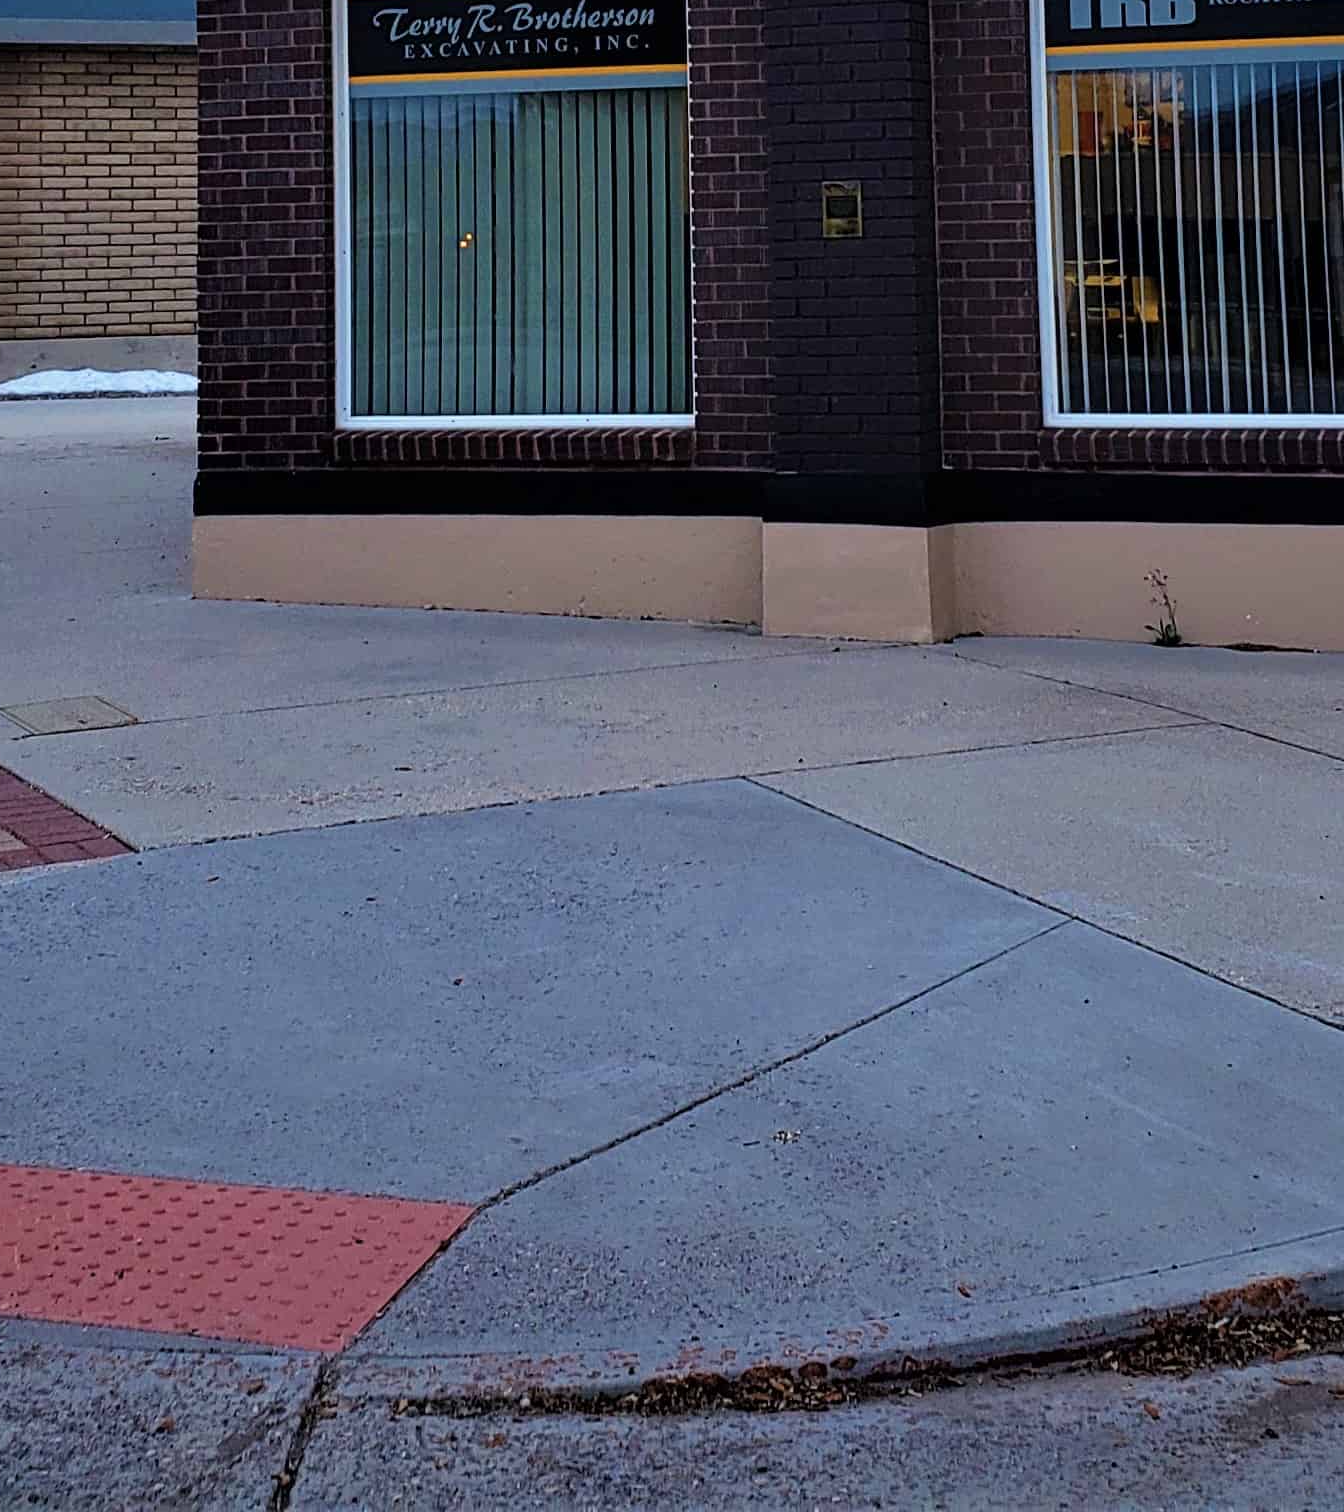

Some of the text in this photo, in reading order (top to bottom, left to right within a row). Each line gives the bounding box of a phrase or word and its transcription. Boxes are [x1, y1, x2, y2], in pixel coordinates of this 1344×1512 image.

[373, 0, 656, 44] Terry R. Brotherson
[404, 33, 651, 59] EXCAVATING, INC.
